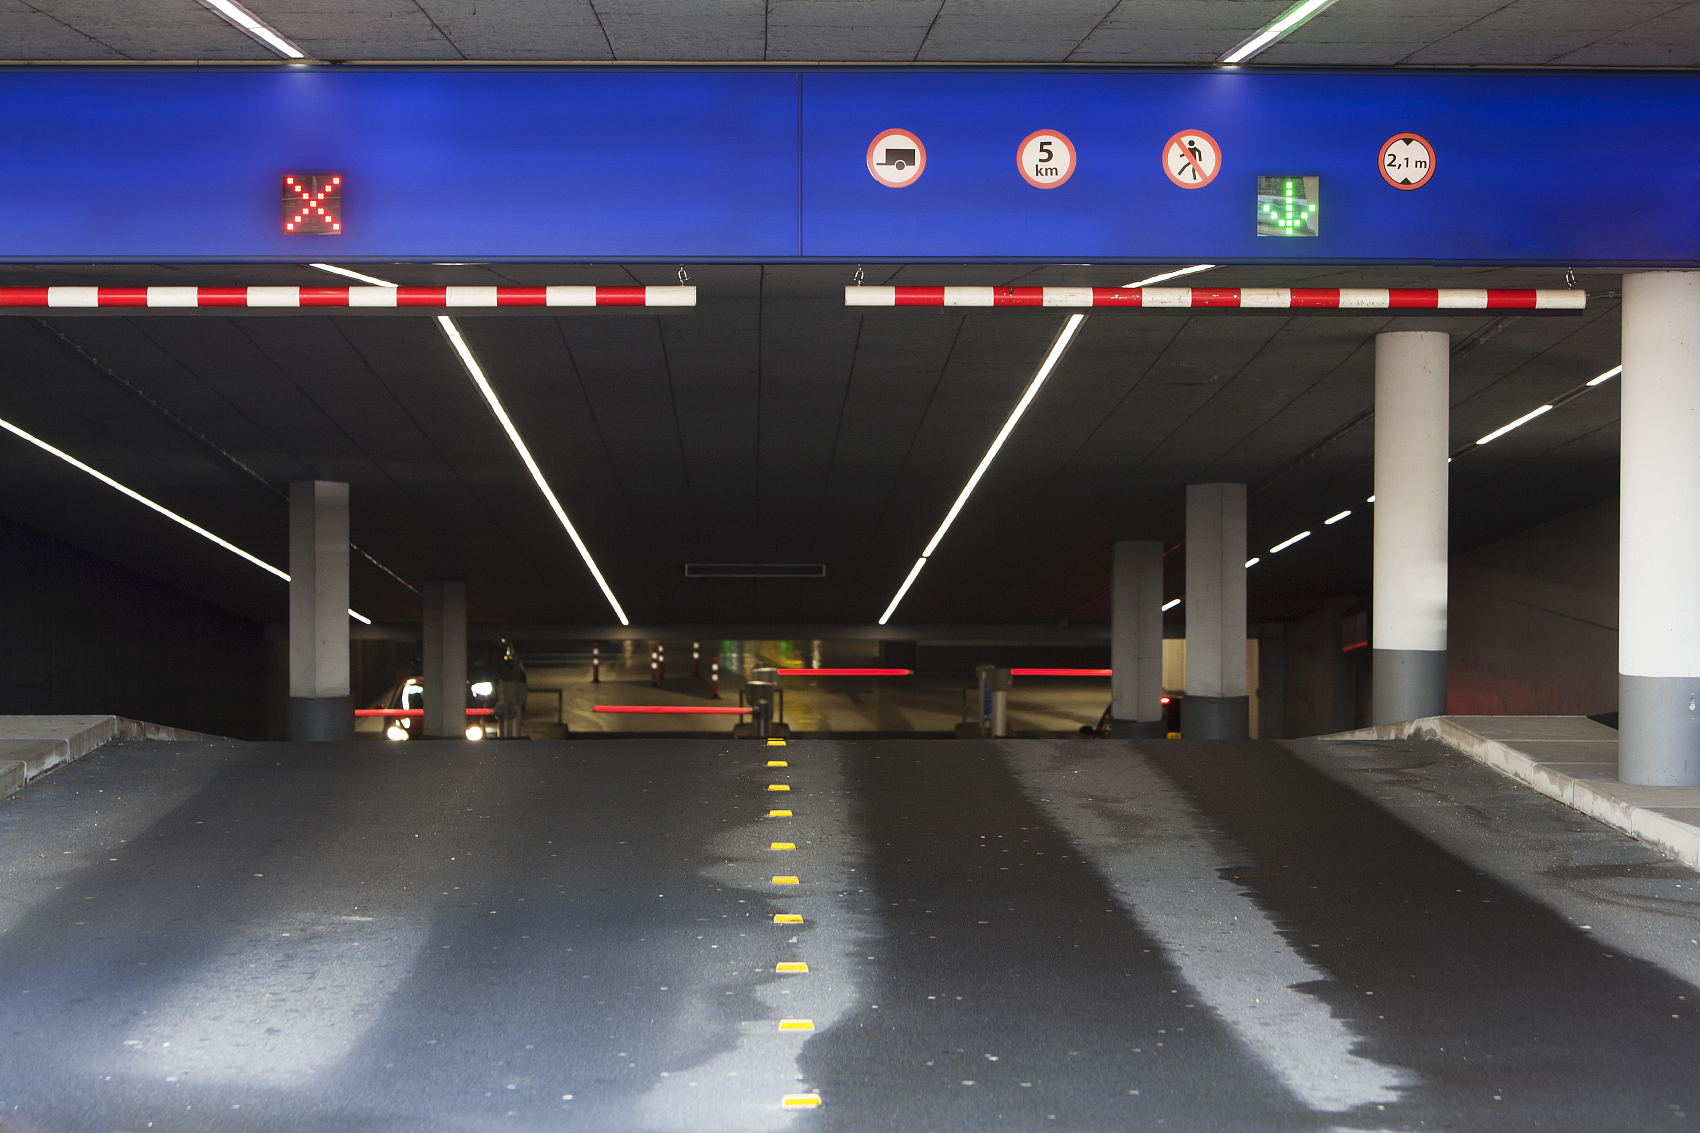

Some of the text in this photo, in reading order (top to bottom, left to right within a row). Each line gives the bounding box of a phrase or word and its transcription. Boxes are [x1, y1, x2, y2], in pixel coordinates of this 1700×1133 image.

[1038, 141, 1054, 163] 5
[1386, 153, 1427, 170] 2,1 m
[1035, 164, 1059, 177] km
